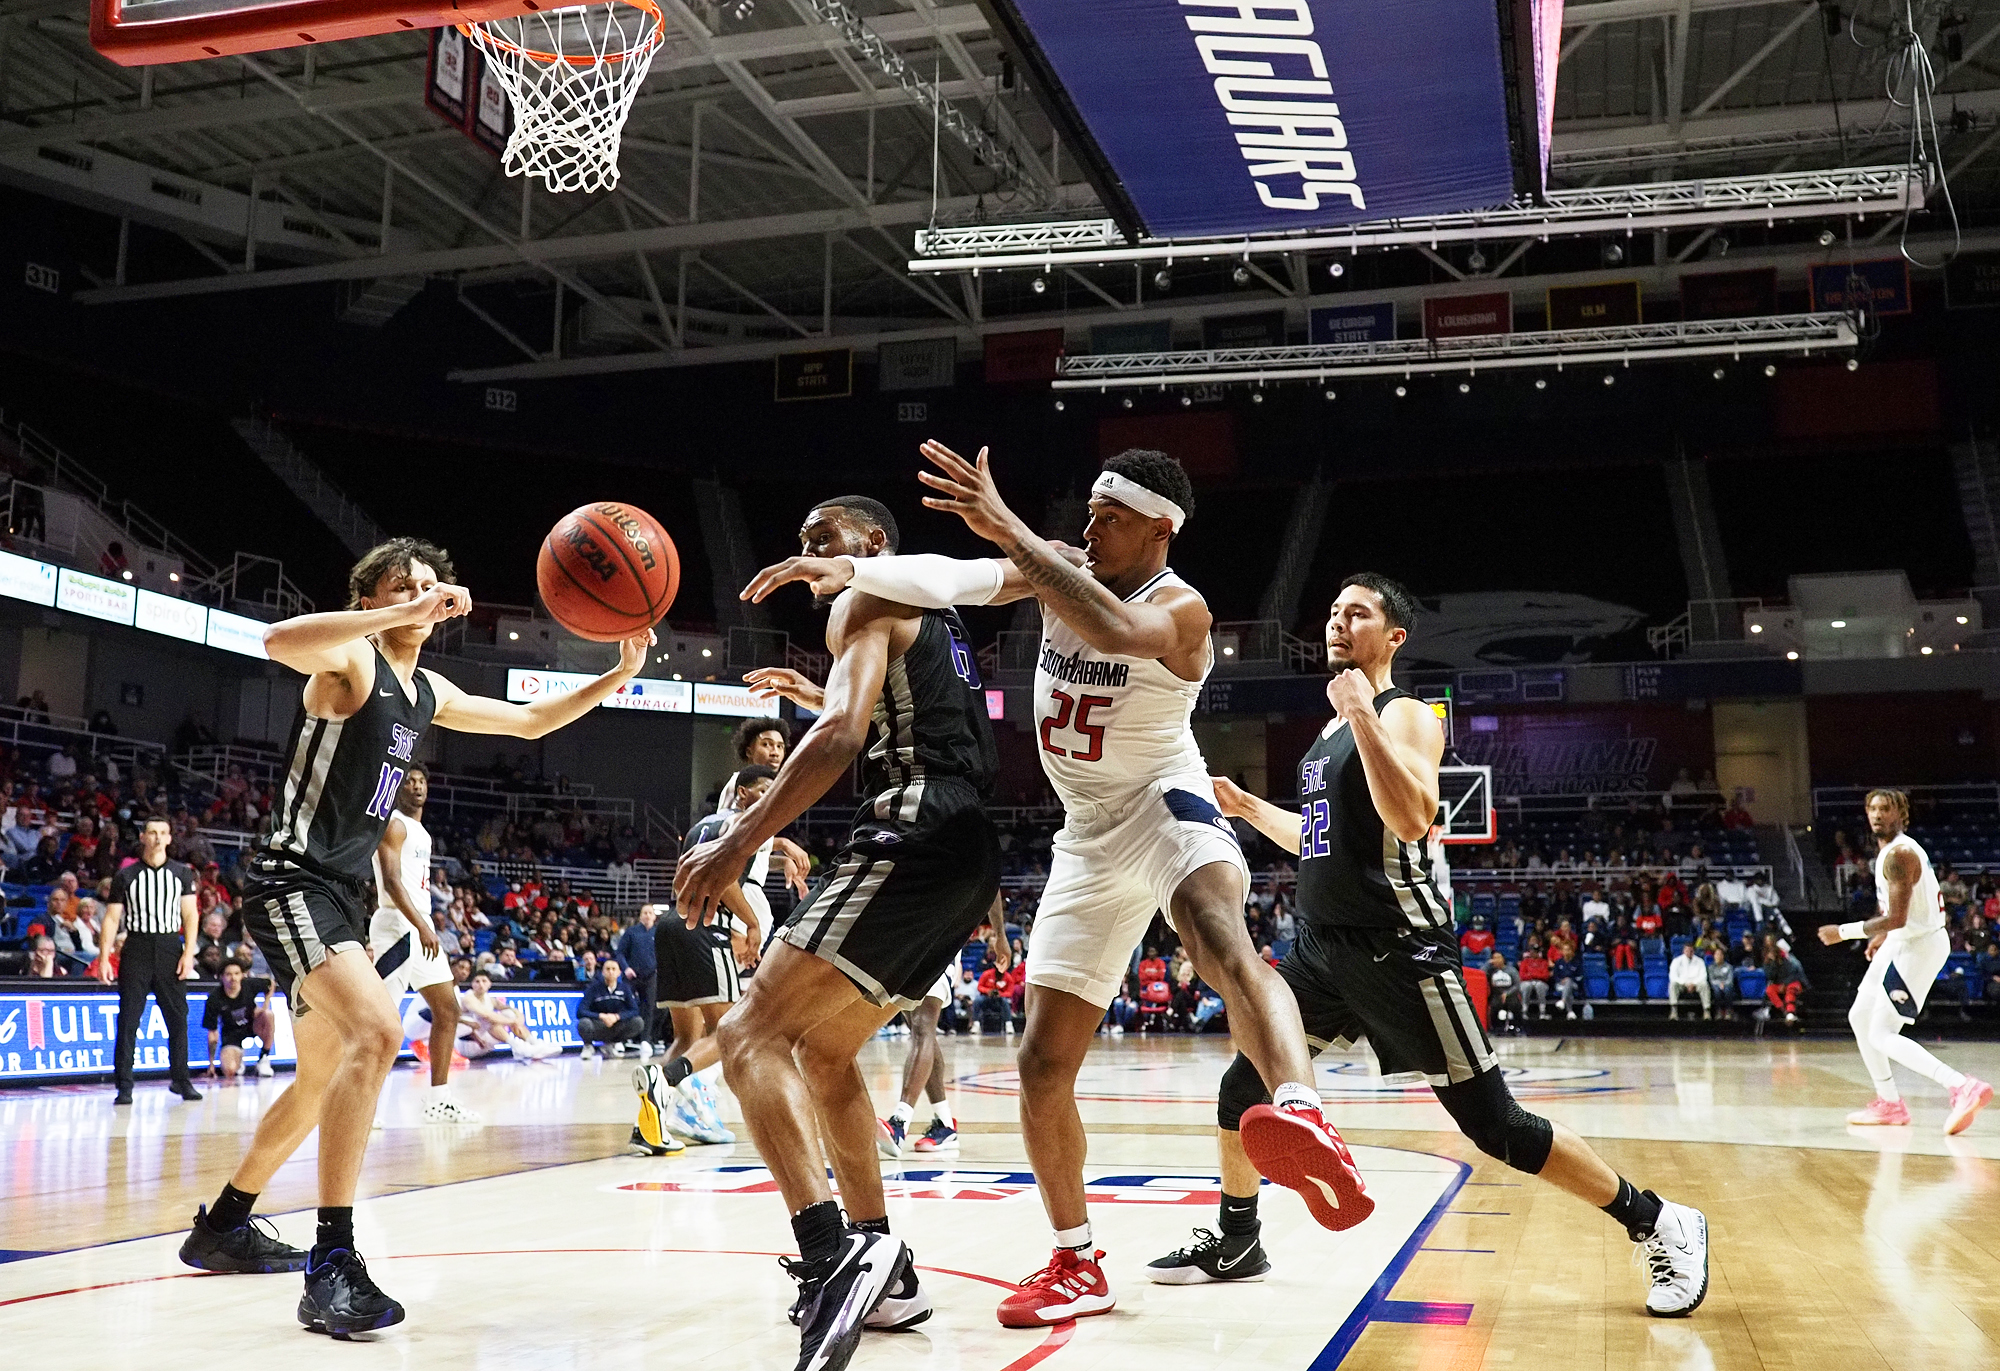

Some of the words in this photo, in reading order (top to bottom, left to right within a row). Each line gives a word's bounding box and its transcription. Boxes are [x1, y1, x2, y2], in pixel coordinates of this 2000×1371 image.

[1580, 303, 1606, 317] ULM
[797, 374, 828, 387] STATE
[488, 390, 516, 411] 312
[900, 403, 926, 420] 313
[594, 502, 656, 573] Wilson
[563, 525, 618, 582] NCAA
[64, 587, 103, 606] SPORTS
[107, 598, 128, 612] BAR
[146, 602, 180, 623] spire
[614, 696, 679, 712] STORAGE
[697, 692, 774, 710] WHATABURGER
[1041, 688, 1113, 762] 25
[387, 722, 419, 763] SHC
[1301, 756, 1331, 795] SHC
[365, 761, 405, 821] 10
[1301, 798, 1332, 861] 22
[53, 1005, 169, 1041] ULTA
[35, 1048, 104, 1071] LIGHT
